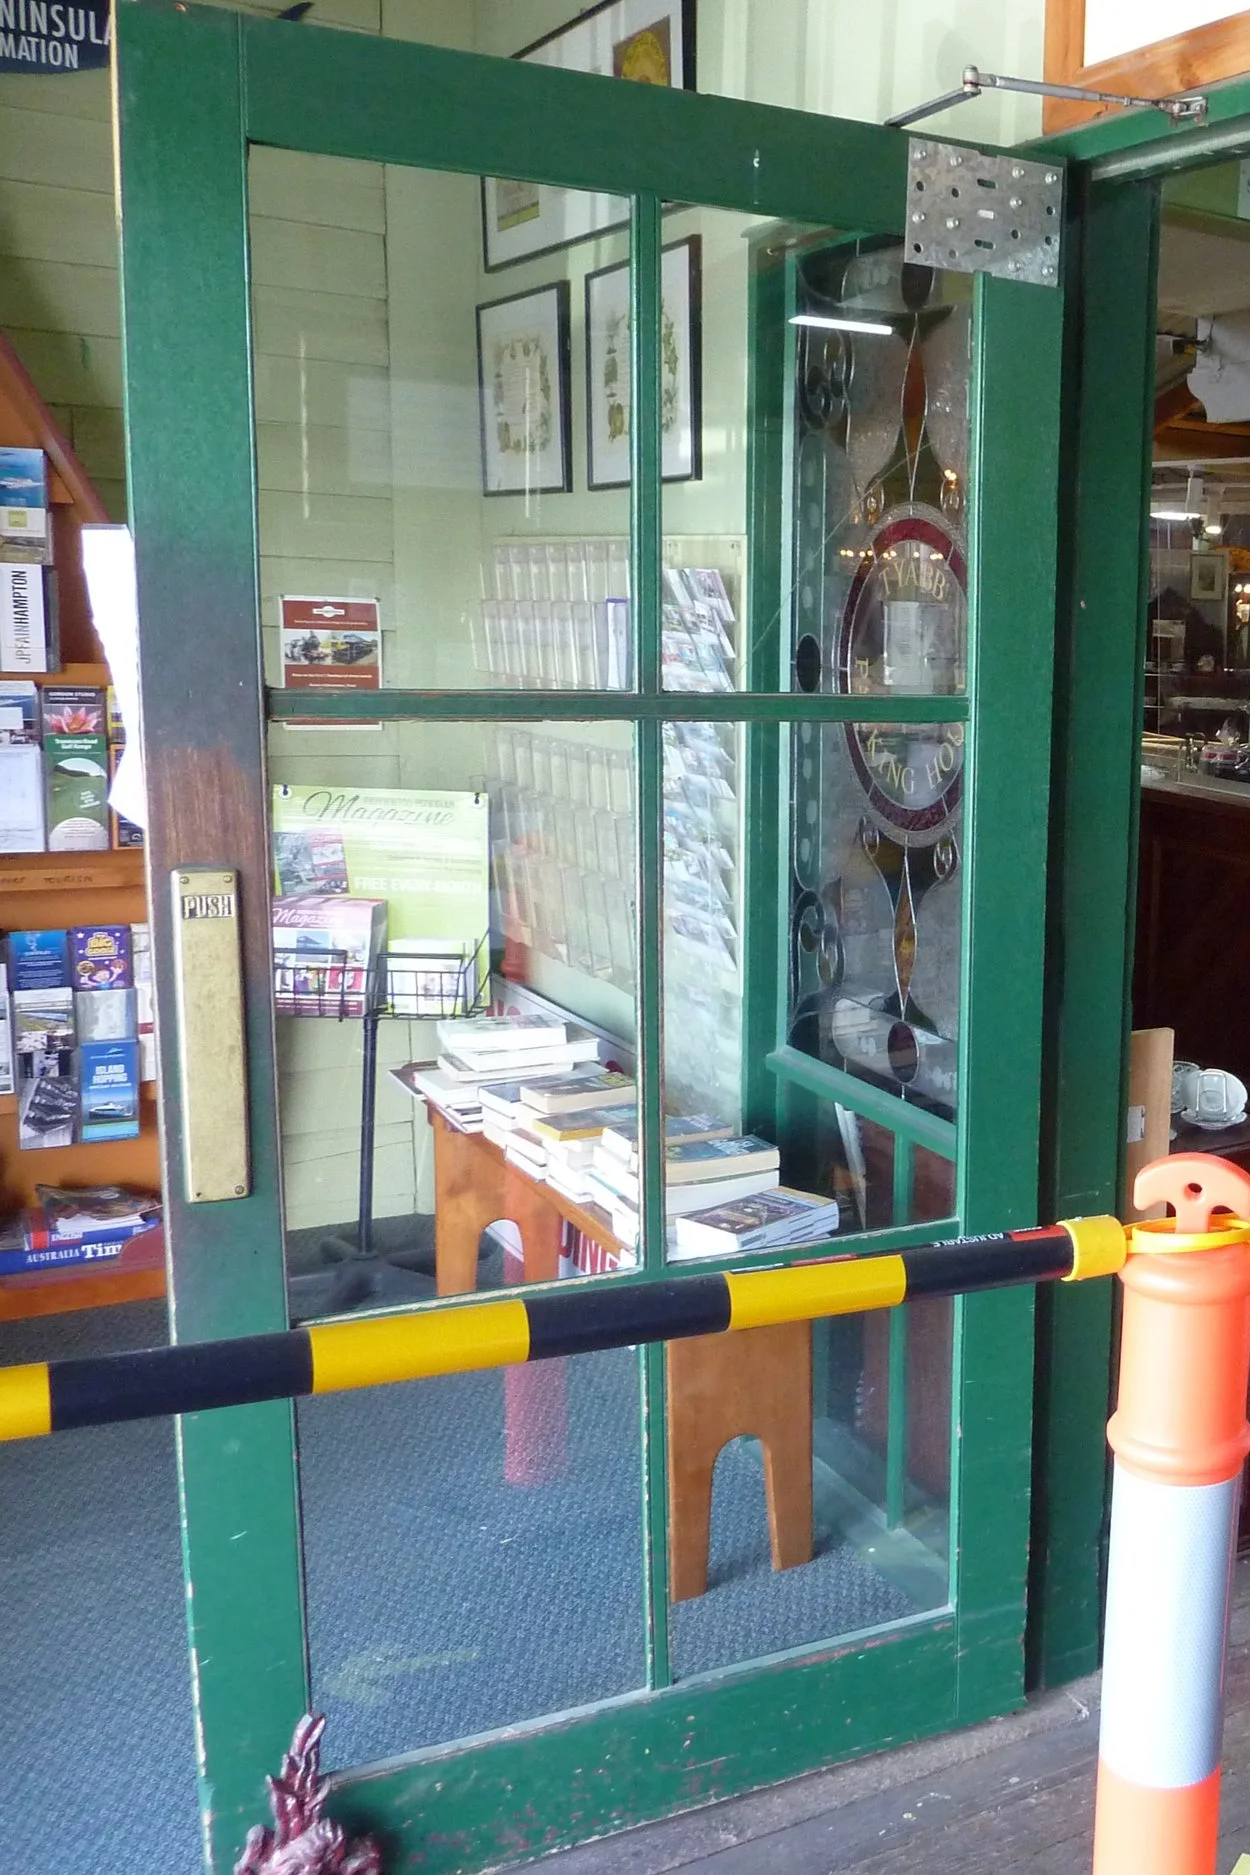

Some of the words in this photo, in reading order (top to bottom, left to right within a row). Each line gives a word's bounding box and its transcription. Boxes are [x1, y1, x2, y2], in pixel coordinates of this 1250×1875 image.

[0, 31, 79, 69] MATION
[879, 558, 947, 600] TYABB
[302, 791, 455, 827] Magazine
[354, 876, 389, 891] FREE
[181, 895, 233, 920] PUSH
[26, 1248, 80, 1264] AUSTRALIA
